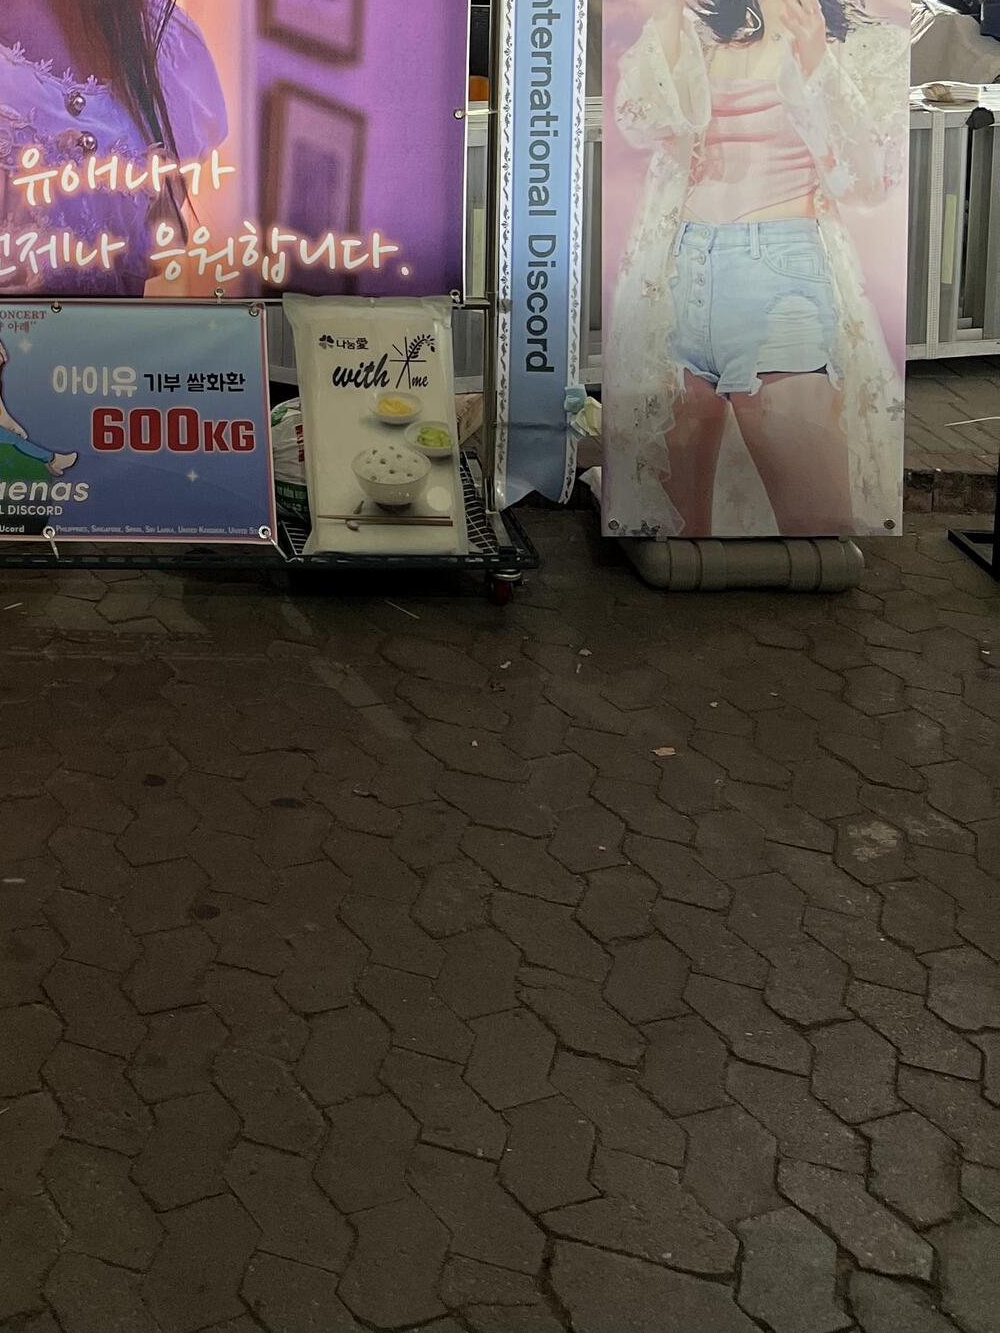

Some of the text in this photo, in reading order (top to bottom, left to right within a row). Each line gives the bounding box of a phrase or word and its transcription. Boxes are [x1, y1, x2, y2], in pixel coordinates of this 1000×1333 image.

[13, 147, 236, 205] 유애나가
[150, 220, 410, 283] 응원합니다.
[525, 234, 557, 373] Discord
[52, 365, 246, 397] 아이유 기부 쌀화환
[332, 353, 390, 389] with
[411, 375, 428, 388] me
[7, 505, 63, 516] DISCORD
